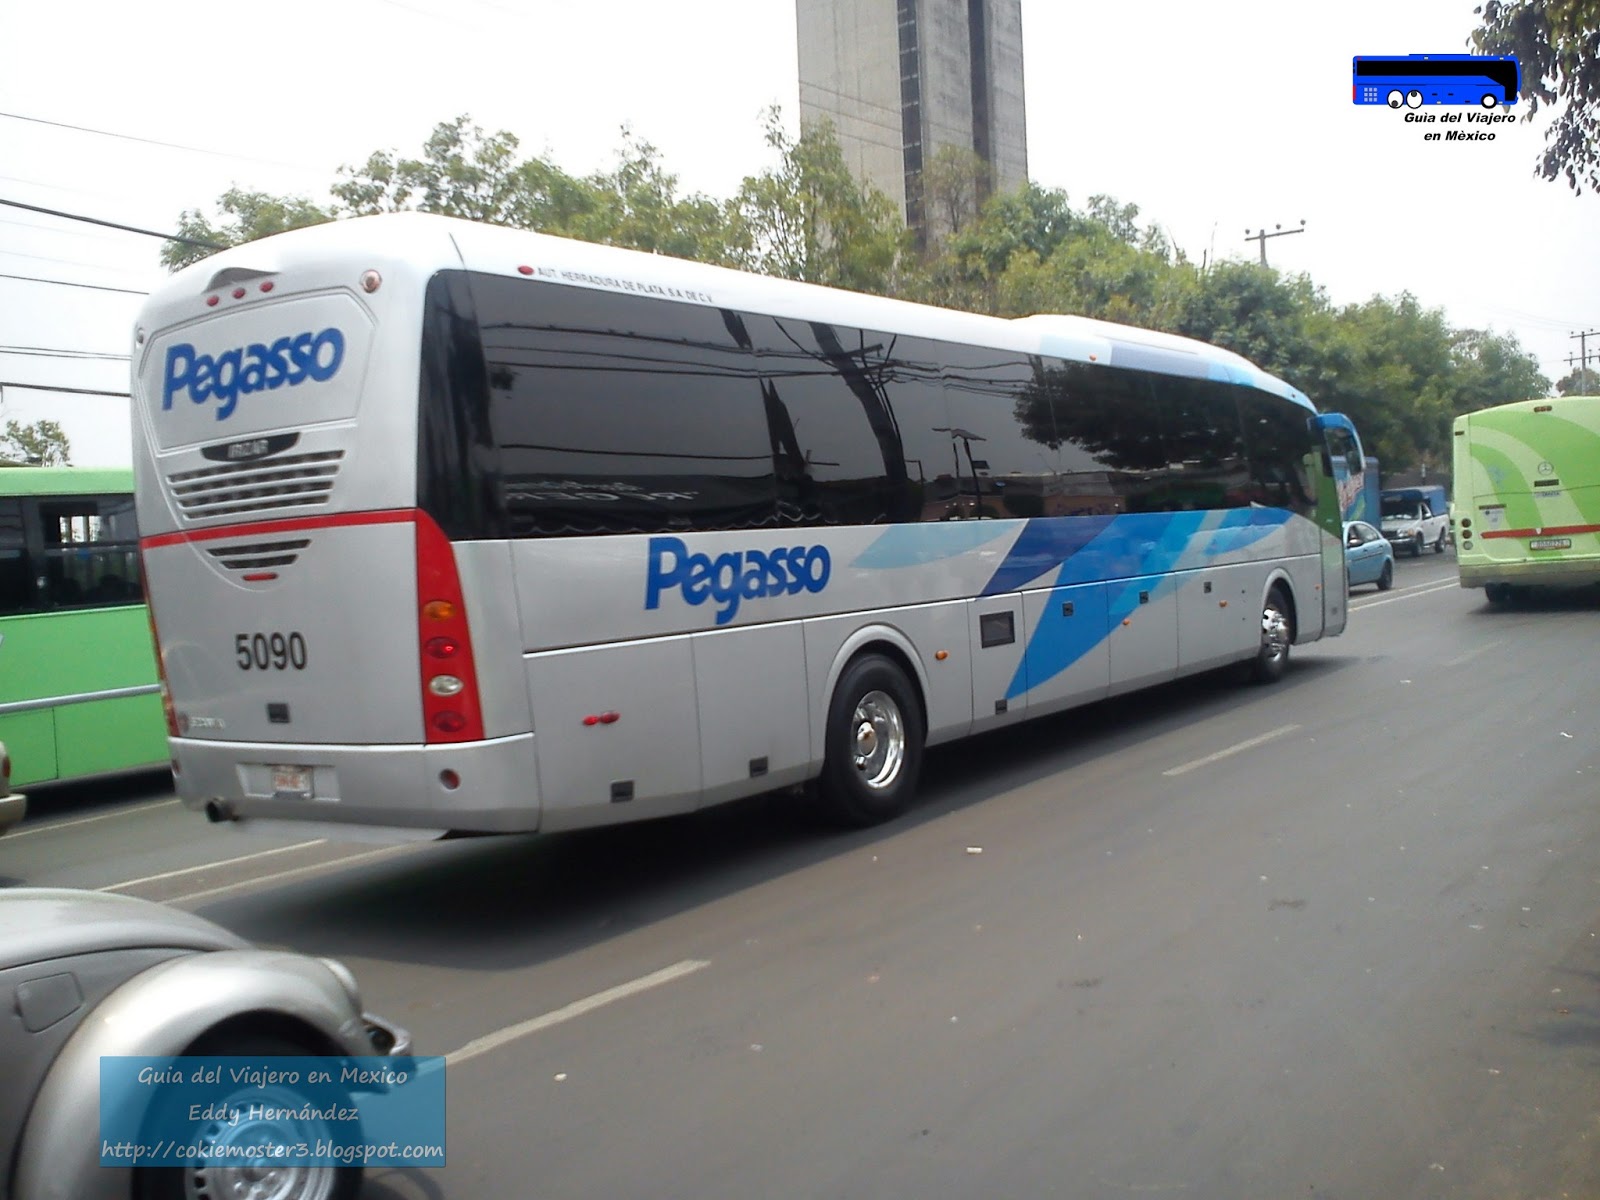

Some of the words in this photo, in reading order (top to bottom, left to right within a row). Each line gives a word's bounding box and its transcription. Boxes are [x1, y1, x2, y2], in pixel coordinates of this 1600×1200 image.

[561, 271, 622, 288] HERRADURA
[622, 280, 636, 292] DE
[636, 282, 666, 296] PLATA
[685, 290, 698, 301] DE
[163, 328, 344, 420] Pegasso
[645, 536, 831, 625] Pegasso
[236, 631, 307, 671] 5090
